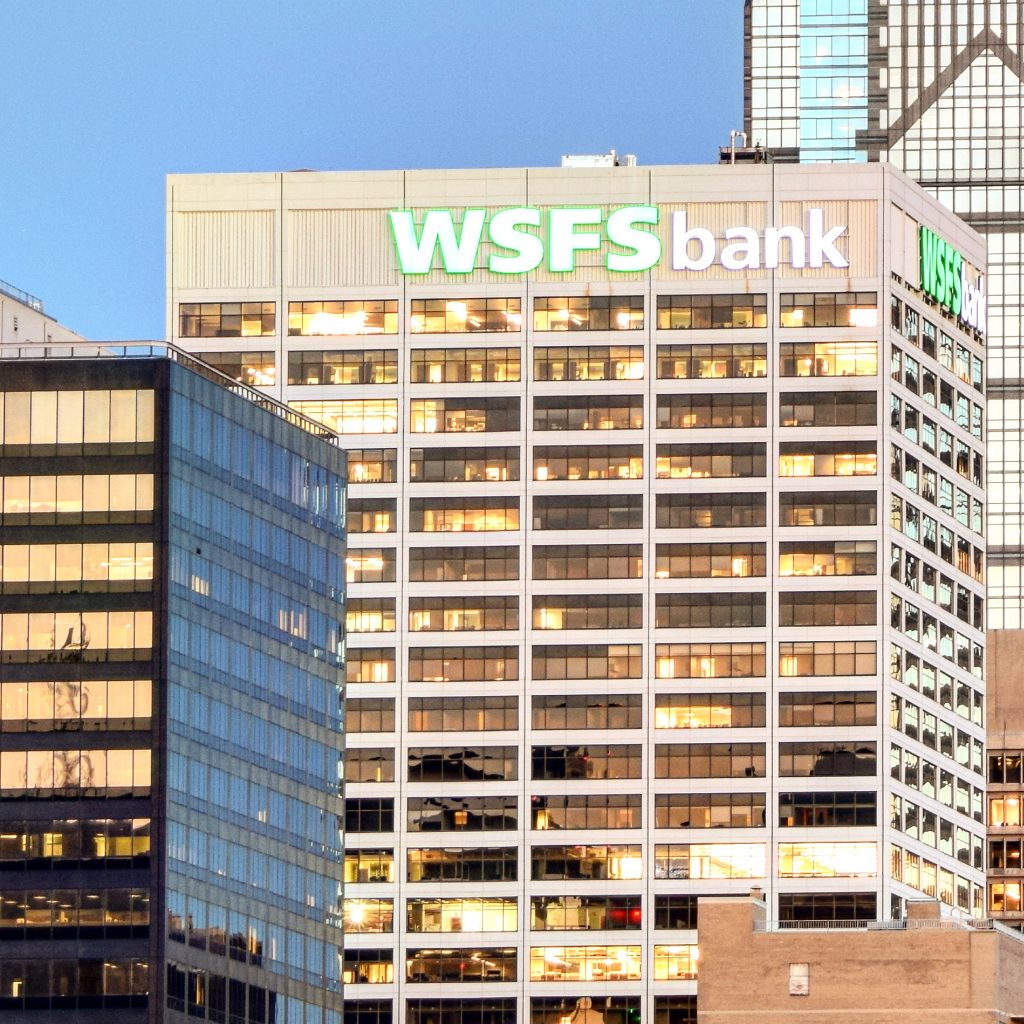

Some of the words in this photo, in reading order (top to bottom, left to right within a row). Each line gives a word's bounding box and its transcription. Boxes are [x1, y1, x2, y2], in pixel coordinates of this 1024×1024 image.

[388, 205, 661, 274] WSFS
[671, 208, 849, 271] bank
[920, 225, 963, 316] WSFS
